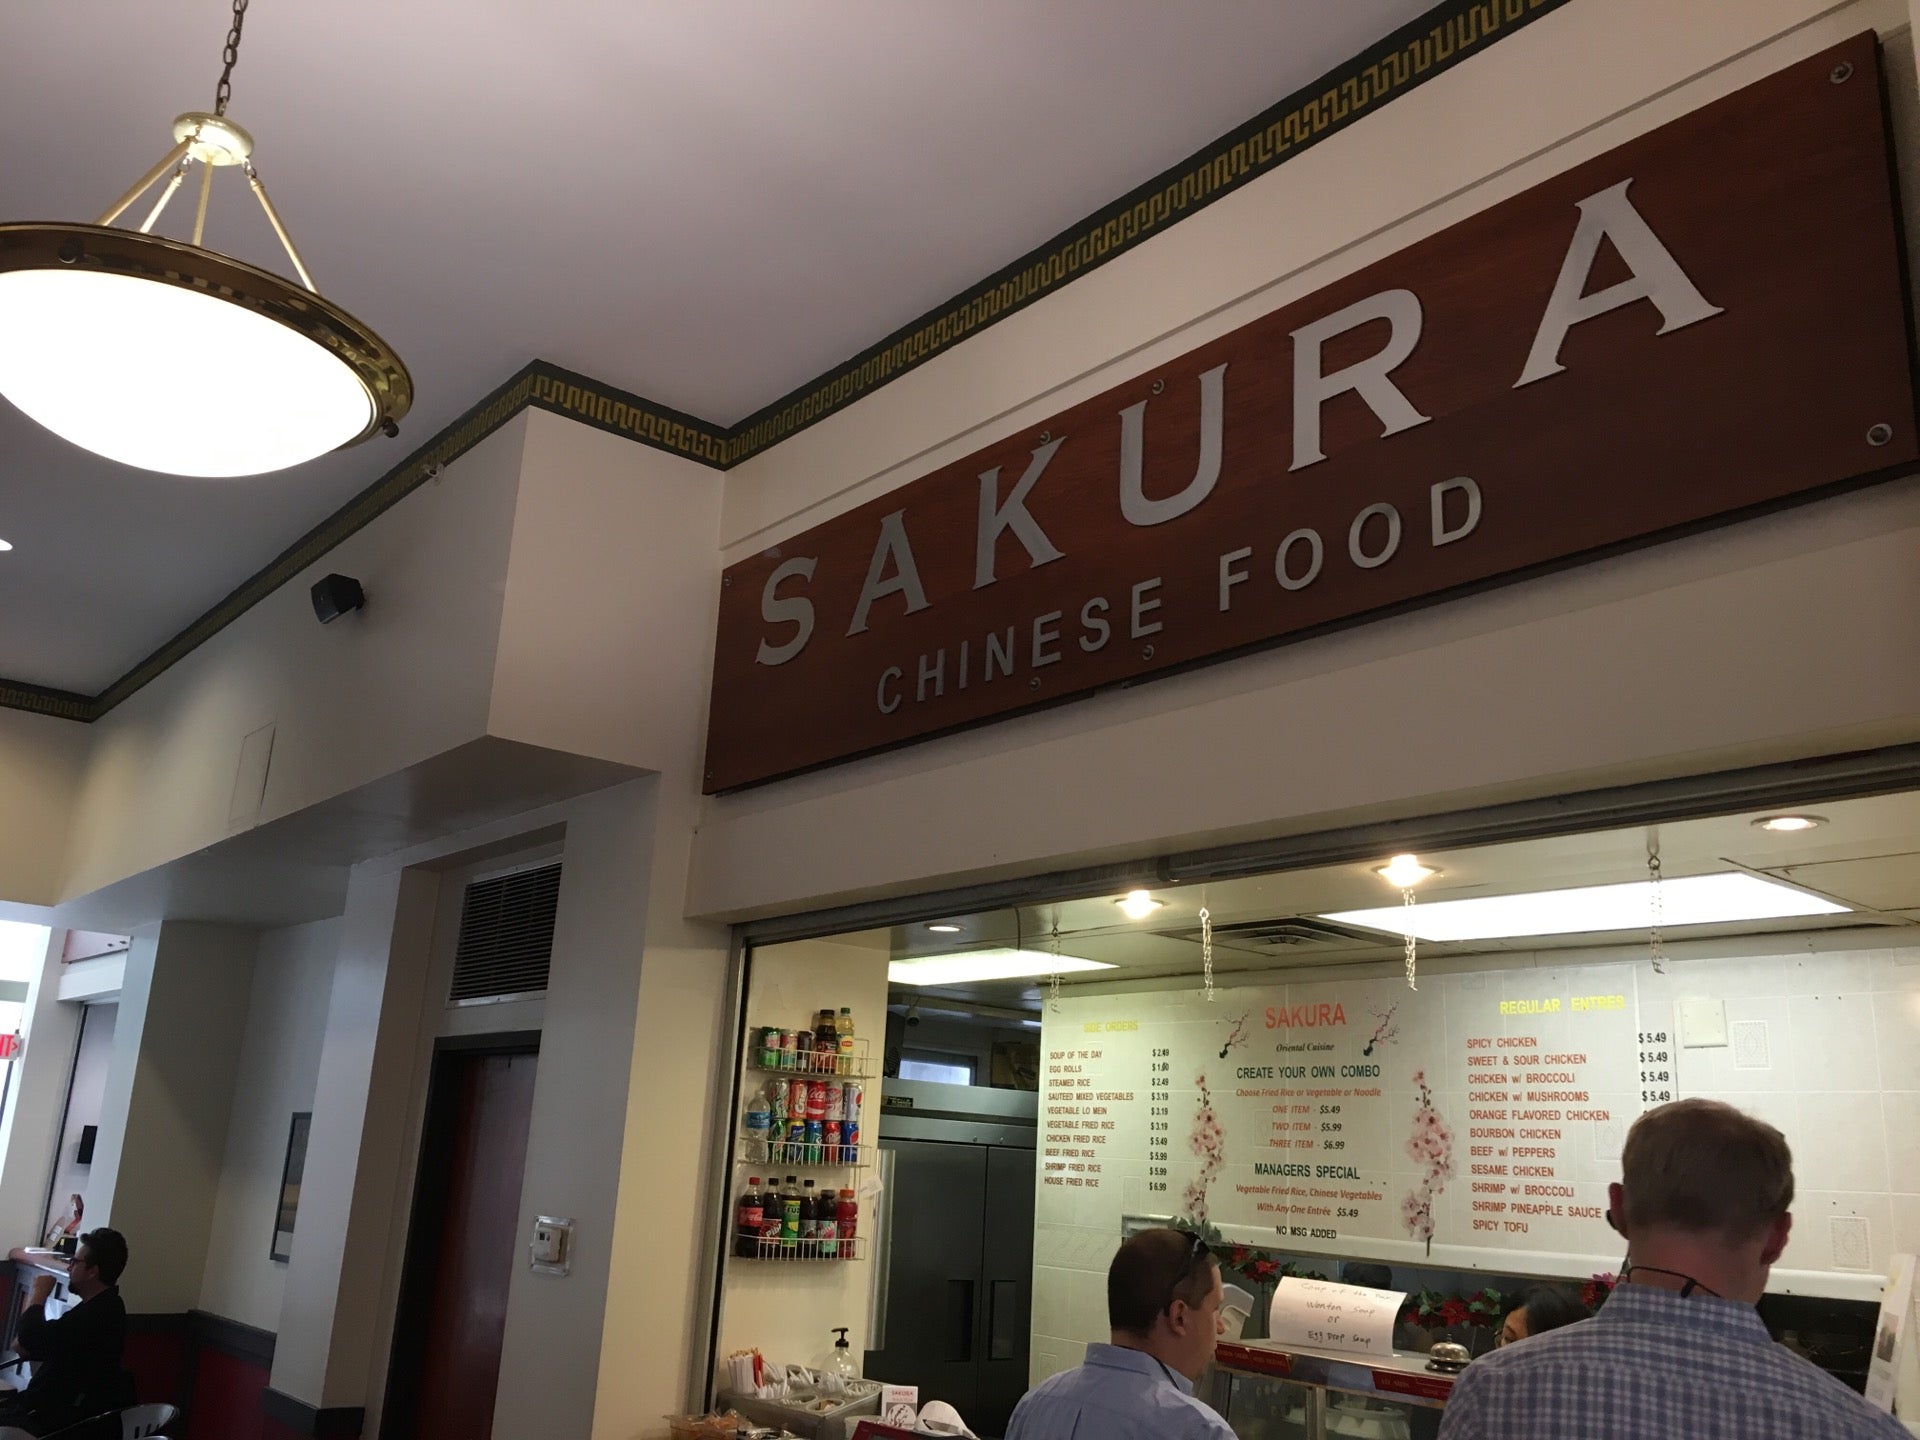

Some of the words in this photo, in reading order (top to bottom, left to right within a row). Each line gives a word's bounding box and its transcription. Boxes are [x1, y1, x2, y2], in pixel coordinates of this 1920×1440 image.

[756, 177, 1725, 667] SAKURA
[876, 577, 1164, 716] CHINESE
[1217, 476, 1483, 612] FOOD
[1500, 998, 1560, 1015] REGULAR
[1265, 1003, 1346, 1029] SAKURA
[1106, 1021, 1137, 1031] ORDERS
[1467, 1038, 1492, 1048] SPICY
[1497, 1038, 1537, 1047] CHICKEN
[1647, 1033, 1667, 1043] 5.49
[1276, 1043, 1305, 1052] Oriental
[1307, 1042, 1334, 1051] Cuisine
[1467, 1056, 1497, 1066] SWEET
[1503, 1056, 1509, 1065] &
[1514, 1055, 1539, 1065] SOUR
[1545, 1054, 1586, 1064] CHICKEN
[1648, 1052, 1668, 1062] 5.49
[1237, 1067, 1273, 1079] CREATE
[1279, 1067, 1305, 1078] YOUR
[1311, 1066, 1335, 1077] OWN
[1341, 1065, 1380, 1077] COMBO
[1649, 1072, 1669, 1082] 5.49
[1468, 1074, 1507, 1084] CHICKEN
[1527, 1073, 1575, 1083] BROCCOLI
[1236, 1088, 1260, 1096] Choose
[1262, 1088, 1278, 1096] Fried
[1280, 1088, 1294, 1096] Rice
[1306, 1088, 1342, 1098] Vegetable
[1354, 1088, 1381, 1096] Noodle
[1469, 1092, 1508, 1101] CHICKEN
[1527, 1091, 1589, 1101] MUSHROOMS
[1651, 1091, 1670, 1101] 5.49
[1291, 1105, 1310, 1114] ITEM
[1320, 1105, 1340, 1114] $5.49
[1470, 1110, 1507, 1120] ORANGE
[1512, 1111, 1560, 1120] FLAVORED
[1567, 1111, 1609, 1120] CHICKEN
[1082, 1121, 1098, 1129] FRIED
[1272, 1122, 1289, 1130] TWO
[1292, 1122, 1311, 1131] ITEM
[1321, 1123, 1341, 1132] $5.99
[1470, 1128, 1514, 1138] BOURBON
[1520, 1129, 1561, 1139] CHICKEN
[1270, 1139, 1291, 1147] THREE
[1295, 1140, 1313, 1148] ITEM
[1324, 1140, 1345, 1149] $6.99
[1062, 1149, 1079, 1157] FRIED
[1471, 1147, 1494, 1156] BEEF
[1513, 1148, 1555, 1158] PEPPERS
[1068, 1163, 1085, 1171] FRIED
[1088, 1164, 1101, 1172] RICE
[1255, 1163, 1310, 1177] MANAGERS
[1316, 1165, 1360, 1180] SPECIAL
[1471, 1165, 1507, 1175] SESAME
[1513, 1166, 1554, 1176] CHICKEN
[1044, 1177, 1063, 1185] HOUSE
[1066, 1178, 1082, 1186] FRIED
[1086, 1179, 1099, 1187] RICE
[1236, 1184, 1270, 1195] Vegetable
[1271, 1186, 1289, 1195] Fried
[1310, 1188, 1338, 1198] Chinese
[1340, 1190, 1383, 1200] Vegetables
[1472, 1183, 1506, 1193] SHRIMP
[1525, 1186, 1574, 1197] BROCCOLI
[1257, 1203, 1274, 1211] With
[1275, 1204, 1289, 1214] Any
[1291, 1205, 1305, 1213] One
[1337, 1208, 1358, 1217] $5.49
[1472, 1201, 1506, 1212] SHRIMP
[1511, 1203, 1563, 1216] PINEAPPLE
[1568, 1207, 1601, 1218] SAUCE
[1276, 1226, 1287, 1235] NO
[1290, 1227, 1307, 1236] MSG
[1311, 1229, 1337, 1238] ADDED
[1473, 1220, 1498, 1230] SPICY
[1504, 1222, 1528, 1233] TOFU
[1353, 1305, 1376, 1317] Soup
[1308, 1330, 1323, 1343] Egg
[1353, 1333, 1371, 1348] Soup
